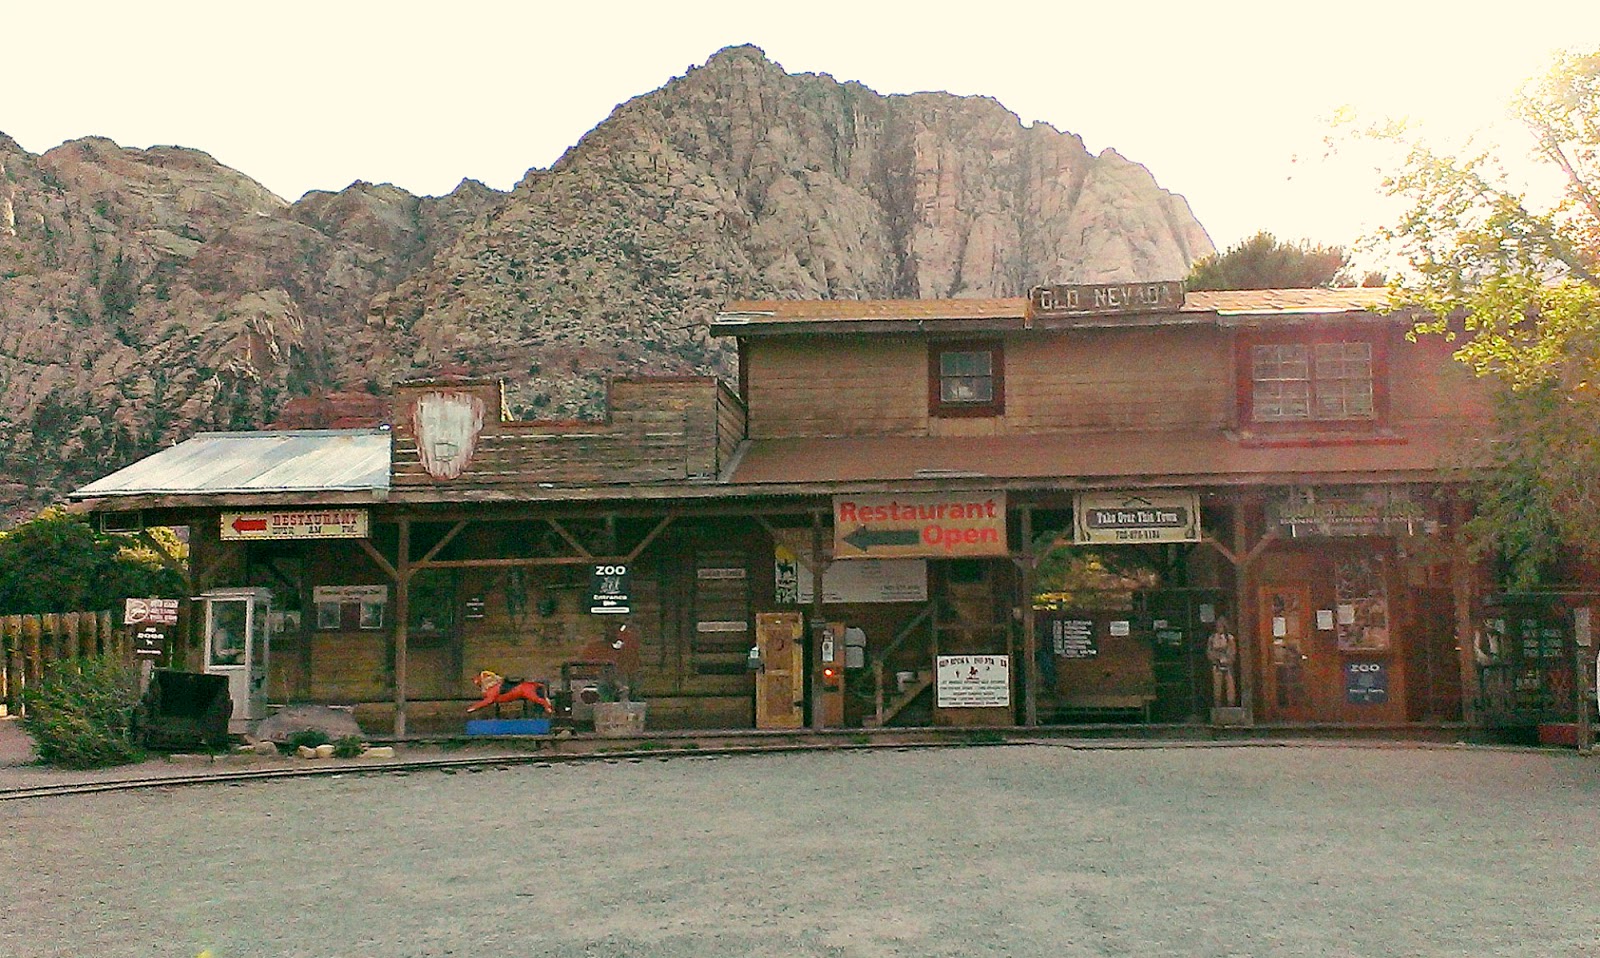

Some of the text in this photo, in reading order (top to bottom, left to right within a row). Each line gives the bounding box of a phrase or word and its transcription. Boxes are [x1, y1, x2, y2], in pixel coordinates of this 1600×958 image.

[1094, 284, 1170, 308] NEVADA
[272, 511, 358, 525] RESTAURANT
[839, 500, 997, 522] Restaurant
[922, 524, 998, 552] Open
[595, 565, 626, 576] ZOO
[1351, 664, 1380, 672] ZOO
